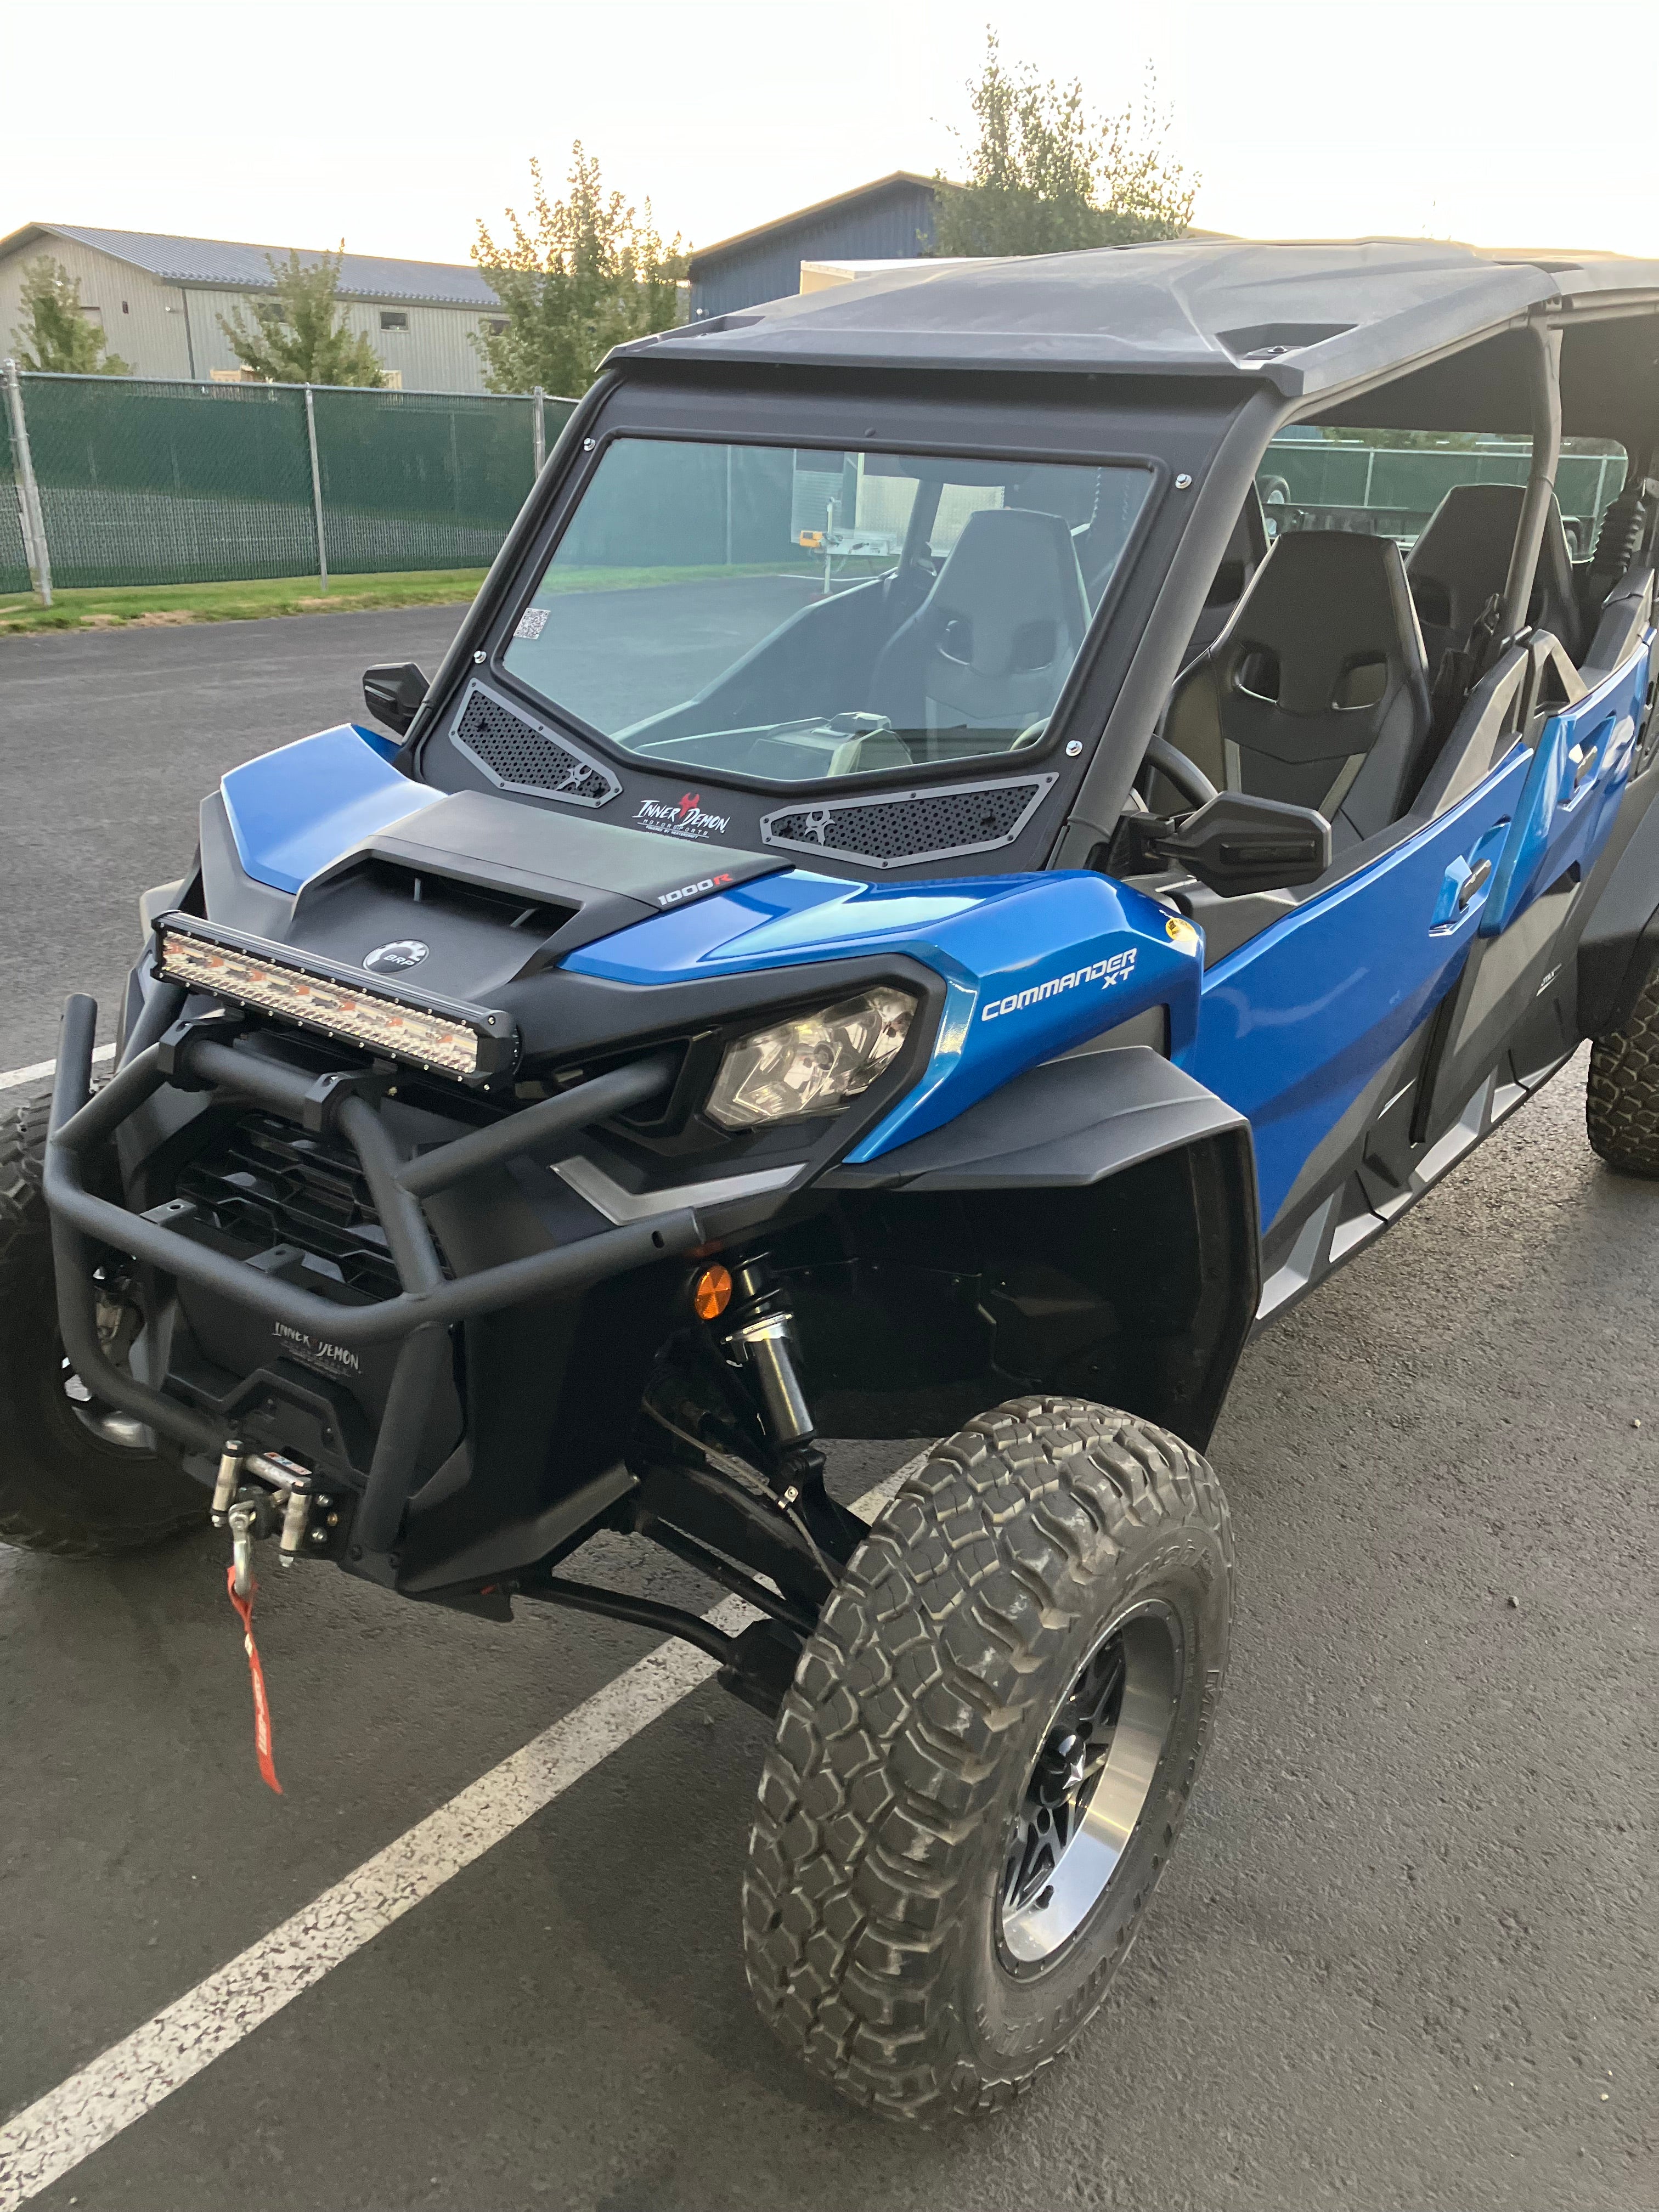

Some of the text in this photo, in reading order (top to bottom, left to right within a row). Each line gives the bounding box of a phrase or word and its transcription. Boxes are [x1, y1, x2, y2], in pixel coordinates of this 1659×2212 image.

[631, 799, 681, 822] INNER
[642, 819, 709, 836] MOTORSPORTS
[658, 873, 733, 906] 1000R
[383, 953, 415, 966] BRP
[981, 947, 1137, 1022] COMMANDER
[1101, 965, 1135, 990] XT
[272, 1322, 311, 1348] INNER
